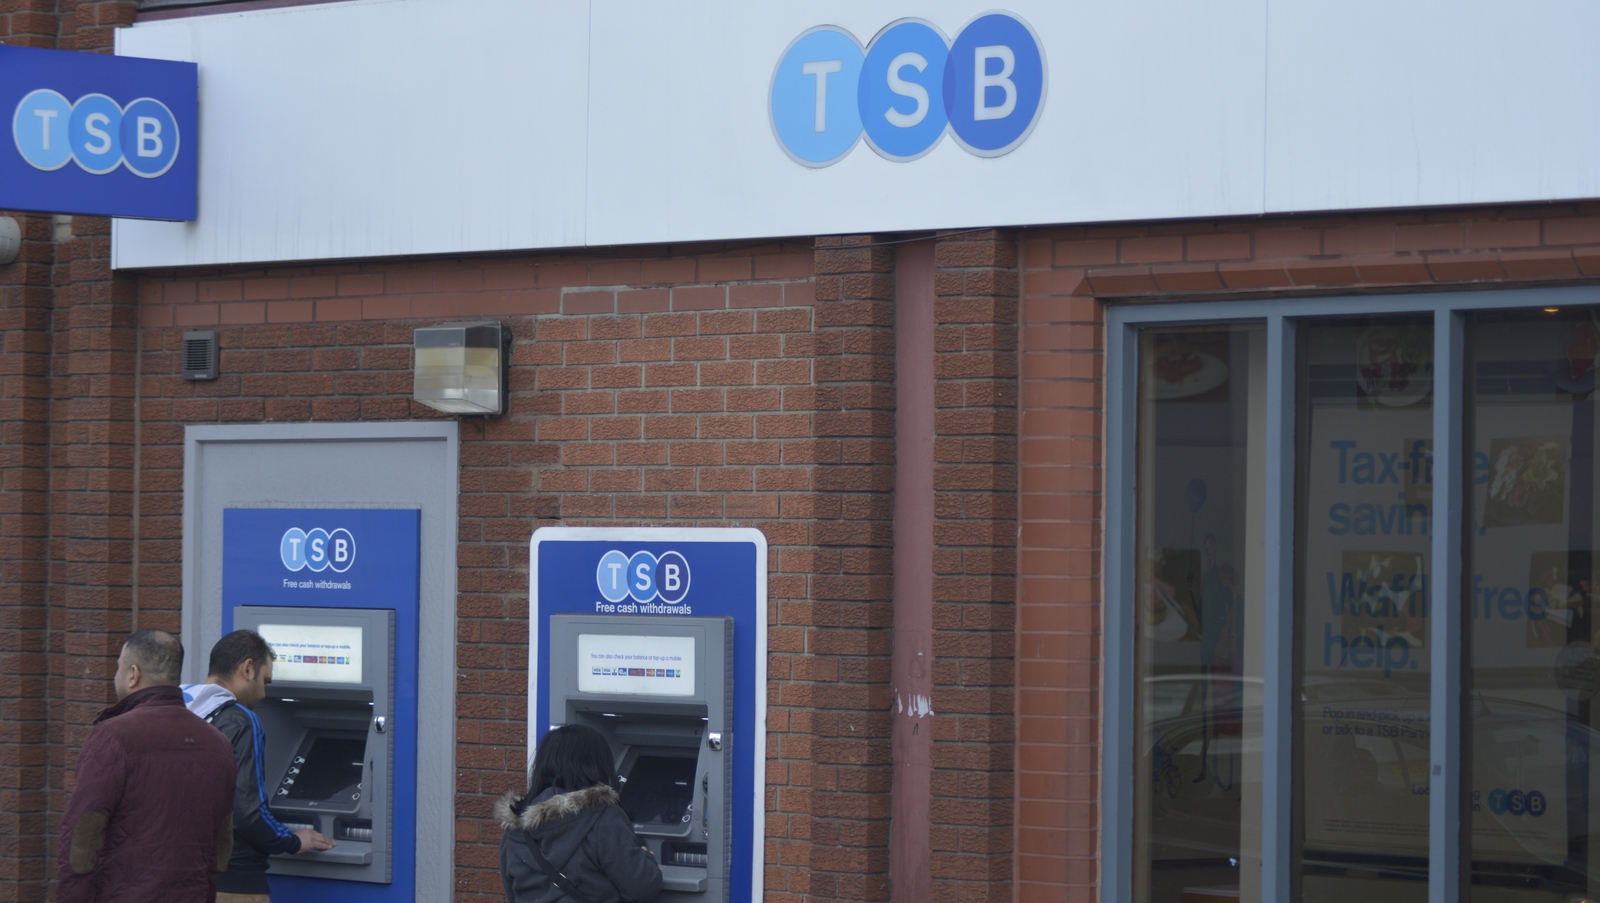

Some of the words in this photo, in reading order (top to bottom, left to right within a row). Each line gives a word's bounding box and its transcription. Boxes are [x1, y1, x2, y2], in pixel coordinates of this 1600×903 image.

[802, 45, 1018, 132] TSB
[34, 109, 163, 158] TSB
[1330, 440, 1490, 485] Tax-fe
[1327, 491, 1487, 544] savin.
[290, 538, 348, 562] TSB
[283, 579, 297, 588] Free
[299, 580, 313, 588] cash
[315, 580, 351, 589] withdrawals
[608, 563, 681, 591] TSB
[596, 602, 615, 612] Free
[617, 603, 637, 613] cash
[640, 603, 691, 614] withdrawals
[1323, 622, 1418, 678] help.
[1323, 706, 1343, 722] Pop
[1346, 708, 1355, 719] in
[1357, 709, 1376, 720] and
[1379, 710, 1400, 723] pick
[1402, 713, 1415, 724] up
[1322, 725, 1333, 735] or
[1335, 724, 1352, 736] talk
[1355, 725, 1365, 736] to
[1367, 727, 1374, 737] a
[1376, 724, 1399, 738] TSB
[1494, 794, 1542, 812] TSB
